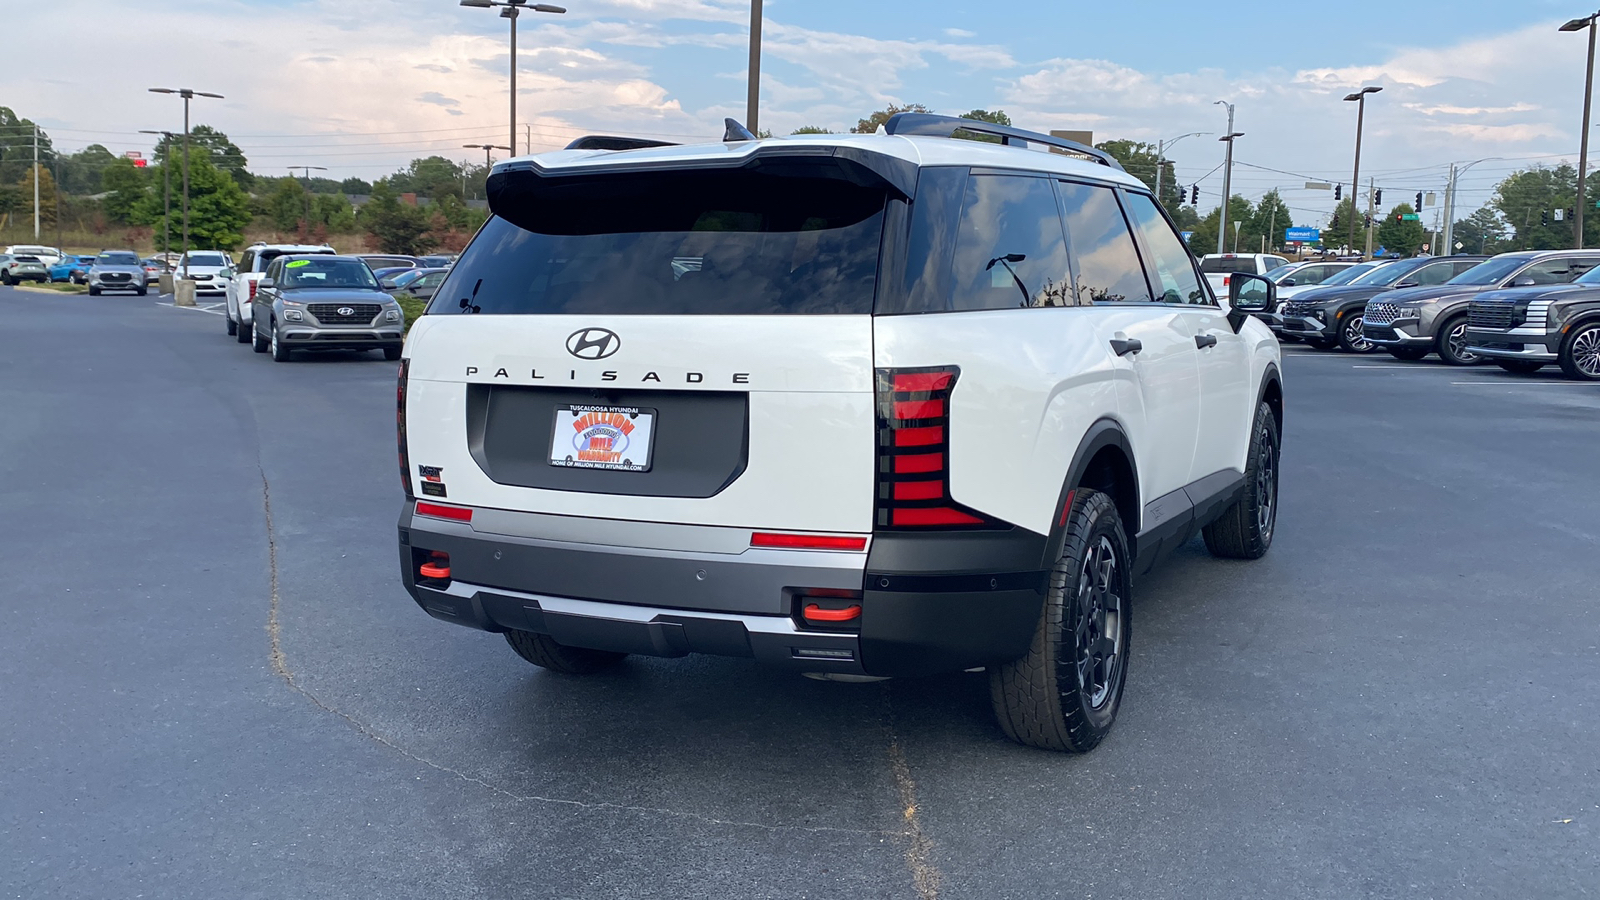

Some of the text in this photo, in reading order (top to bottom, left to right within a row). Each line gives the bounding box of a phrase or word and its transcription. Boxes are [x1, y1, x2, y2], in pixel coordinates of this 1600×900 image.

[466, 366, 750, 384] PALISADE
[570, 405, 608, 413] TUSCALOOSA
[572, 412, 636, 437] MILLION
[589, 437, 613, 451] MILE
[578, 450, 622, 462] WARRANTY
